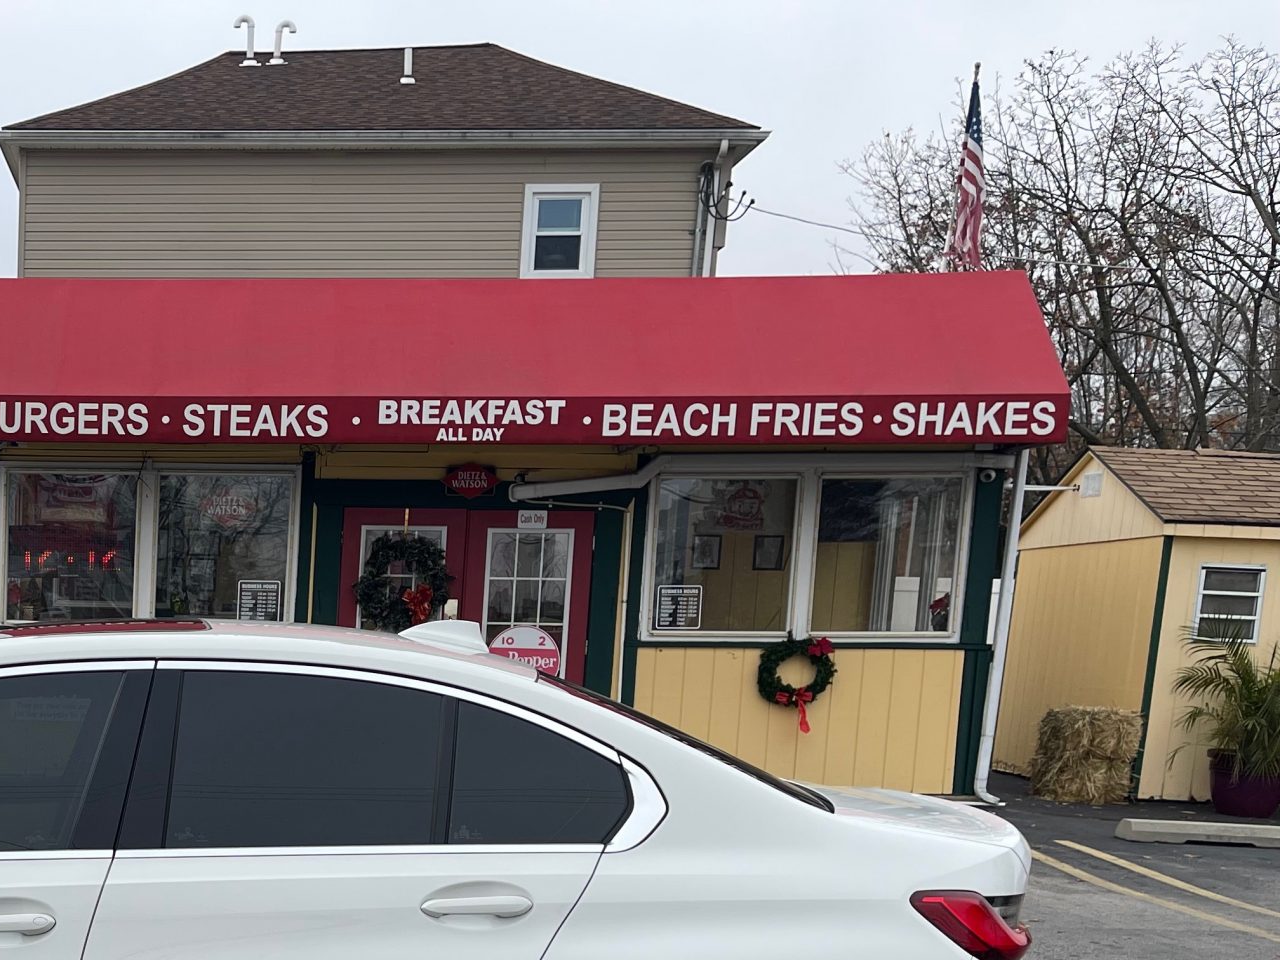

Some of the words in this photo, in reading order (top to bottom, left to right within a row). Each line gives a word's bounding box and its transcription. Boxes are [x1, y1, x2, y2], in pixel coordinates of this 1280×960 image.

[182, 403, 329, 438] STEAKS
[378, 399, 566, 425] BREAKFAST
[602, 403, 738, 437] BEACH
[749, 402, 864, 437] FRIES
[890, 401, 1056, 437] SHAKES
[435, 427, 468, 442] ALL
[472, 427, 505, 442] DAY
[451, 479, 488, 489] WATSON
[207, 505, 246, 515] WATSON
[520, 513, 533, 524] Cash
[533, 513, 545, 525] Only
[501, 636, 515, 646] 10
[538, 636, 546, 646] 2
